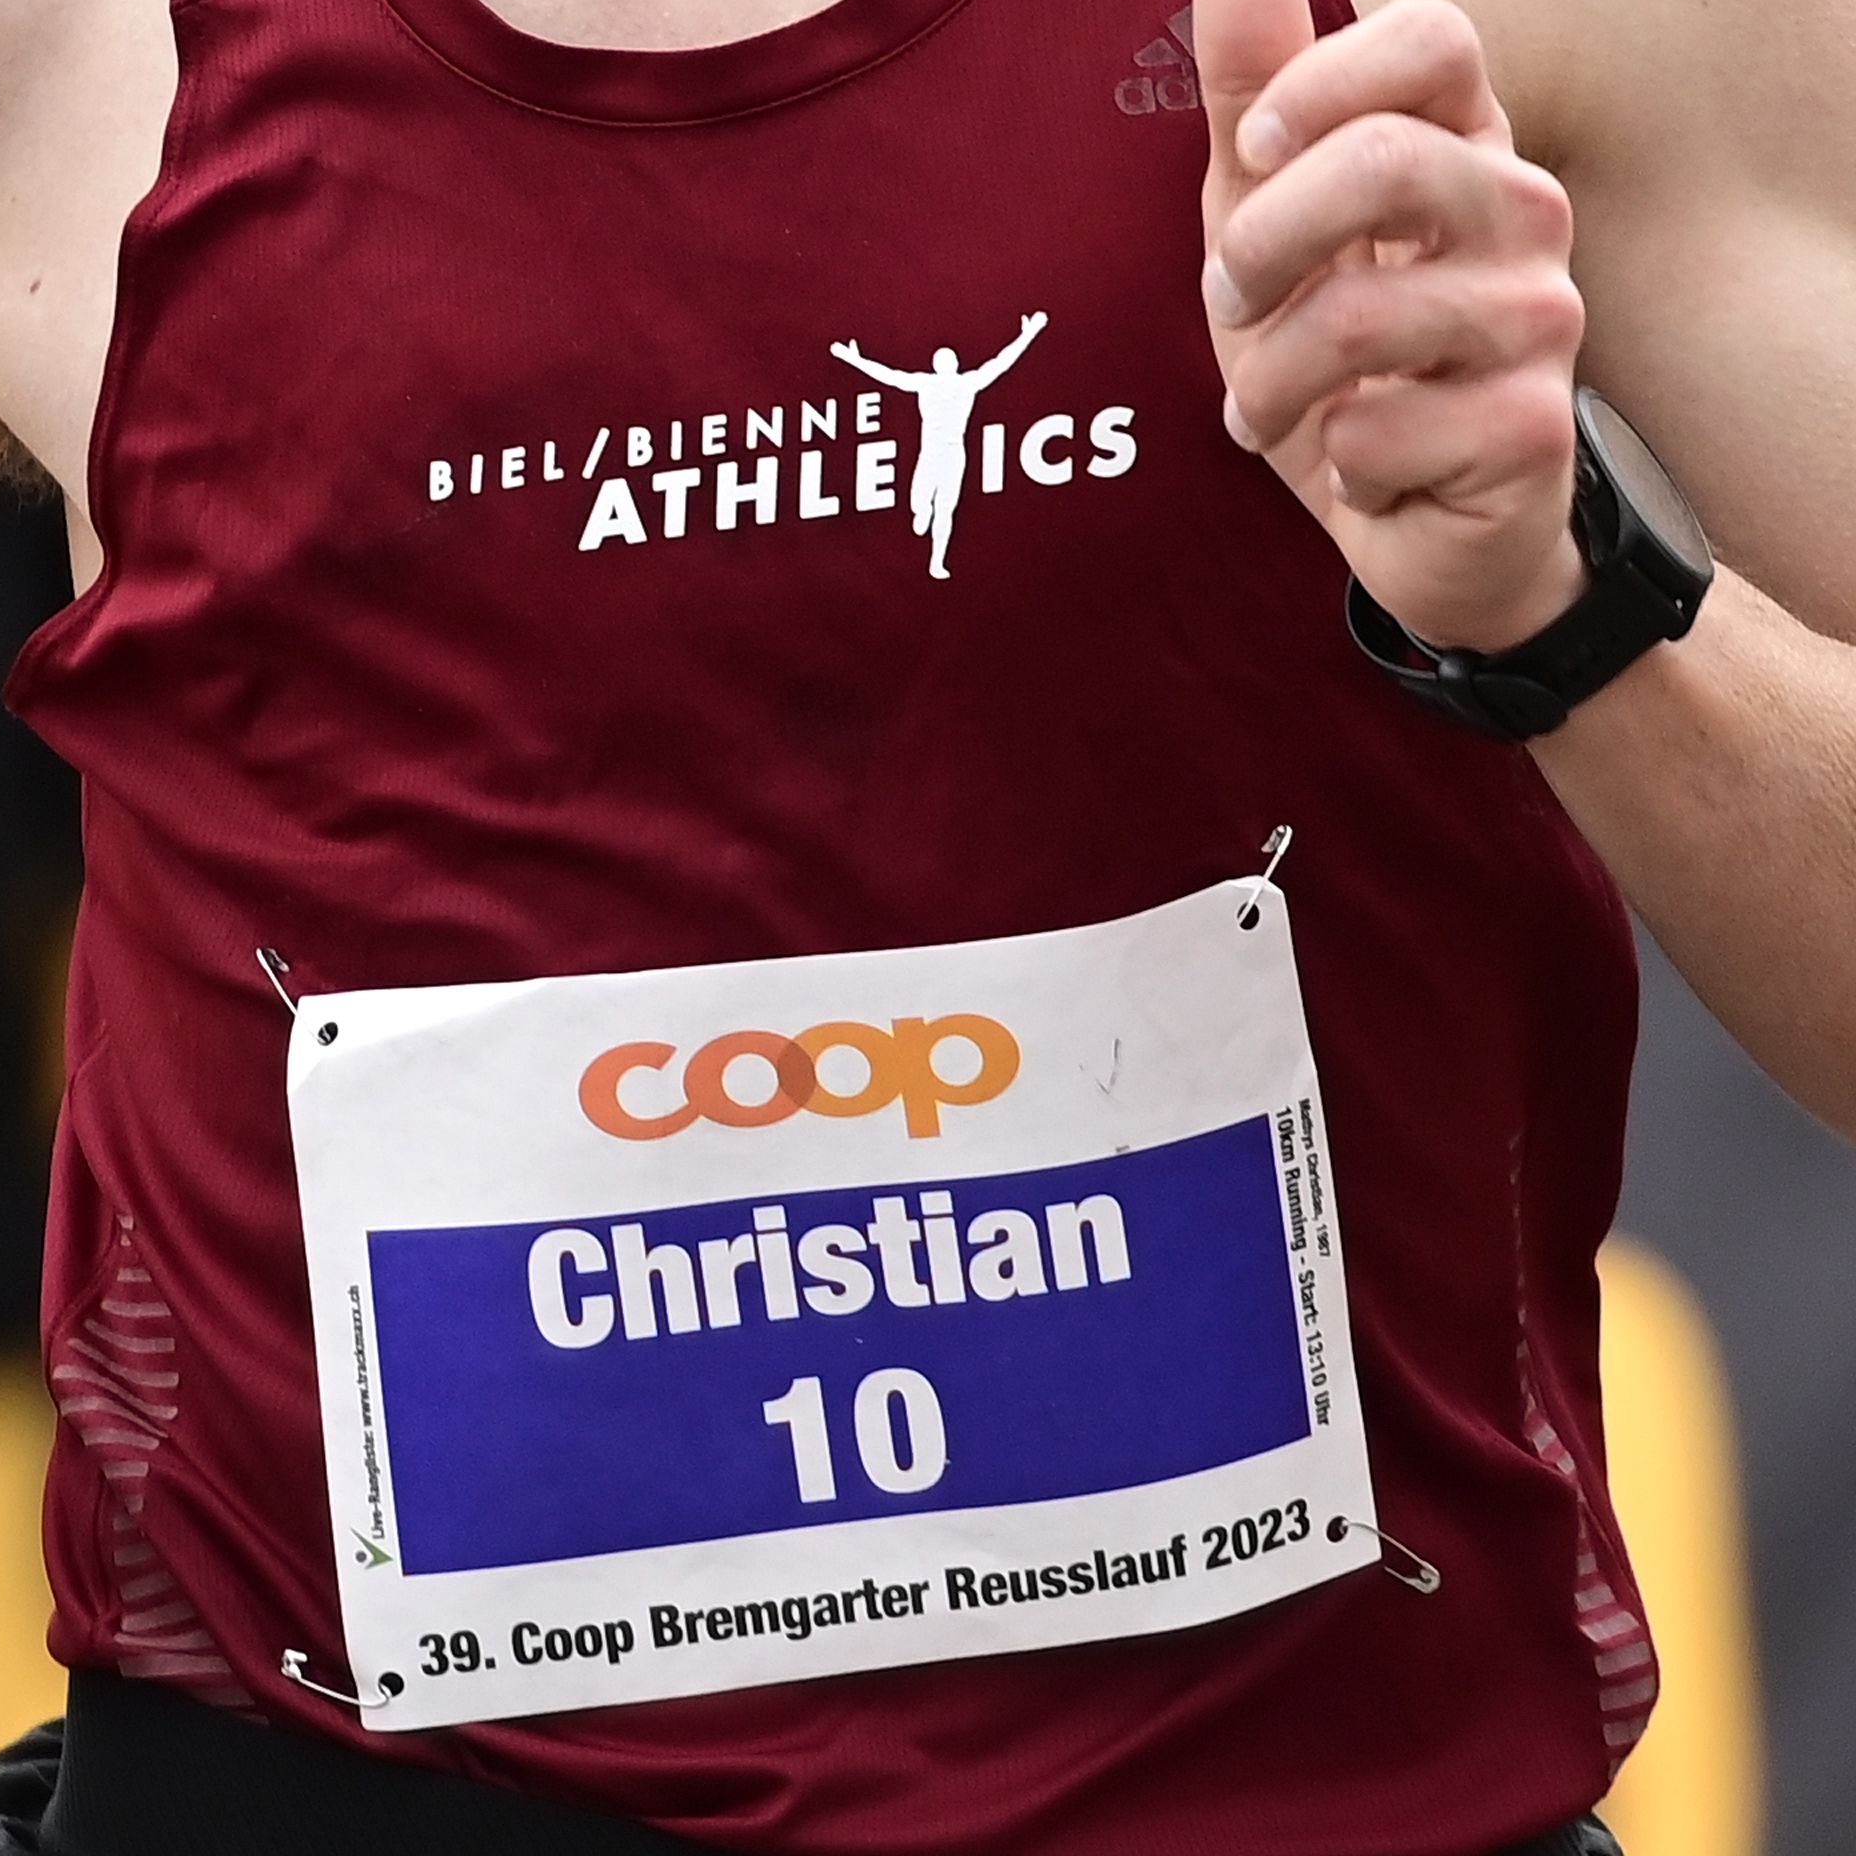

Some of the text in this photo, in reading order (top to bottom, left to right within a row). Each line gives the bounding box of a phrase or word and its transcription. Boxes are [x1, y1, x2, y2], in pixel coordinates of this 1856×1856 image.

[428, 391, 883, 502] BIEL/BIENNE
[578, 1012, 1022, 1141] coop
[1276, 1105, 1295, 1163] 10km
[1284, 1167, 1309, 1252] Running
[527, 1189, 1132, 1349] Christian
[1298, 1269, 1320, 1326] Start:
[1306, 1330, 1327, 1387] 13:10
[762, 1367, 946, 1504] 10
[1314, 1391, 1331, 1427] Uhr
[419, 1497, 1312, 1677] 39. Coop Bremgarter Reusslauf 2023
